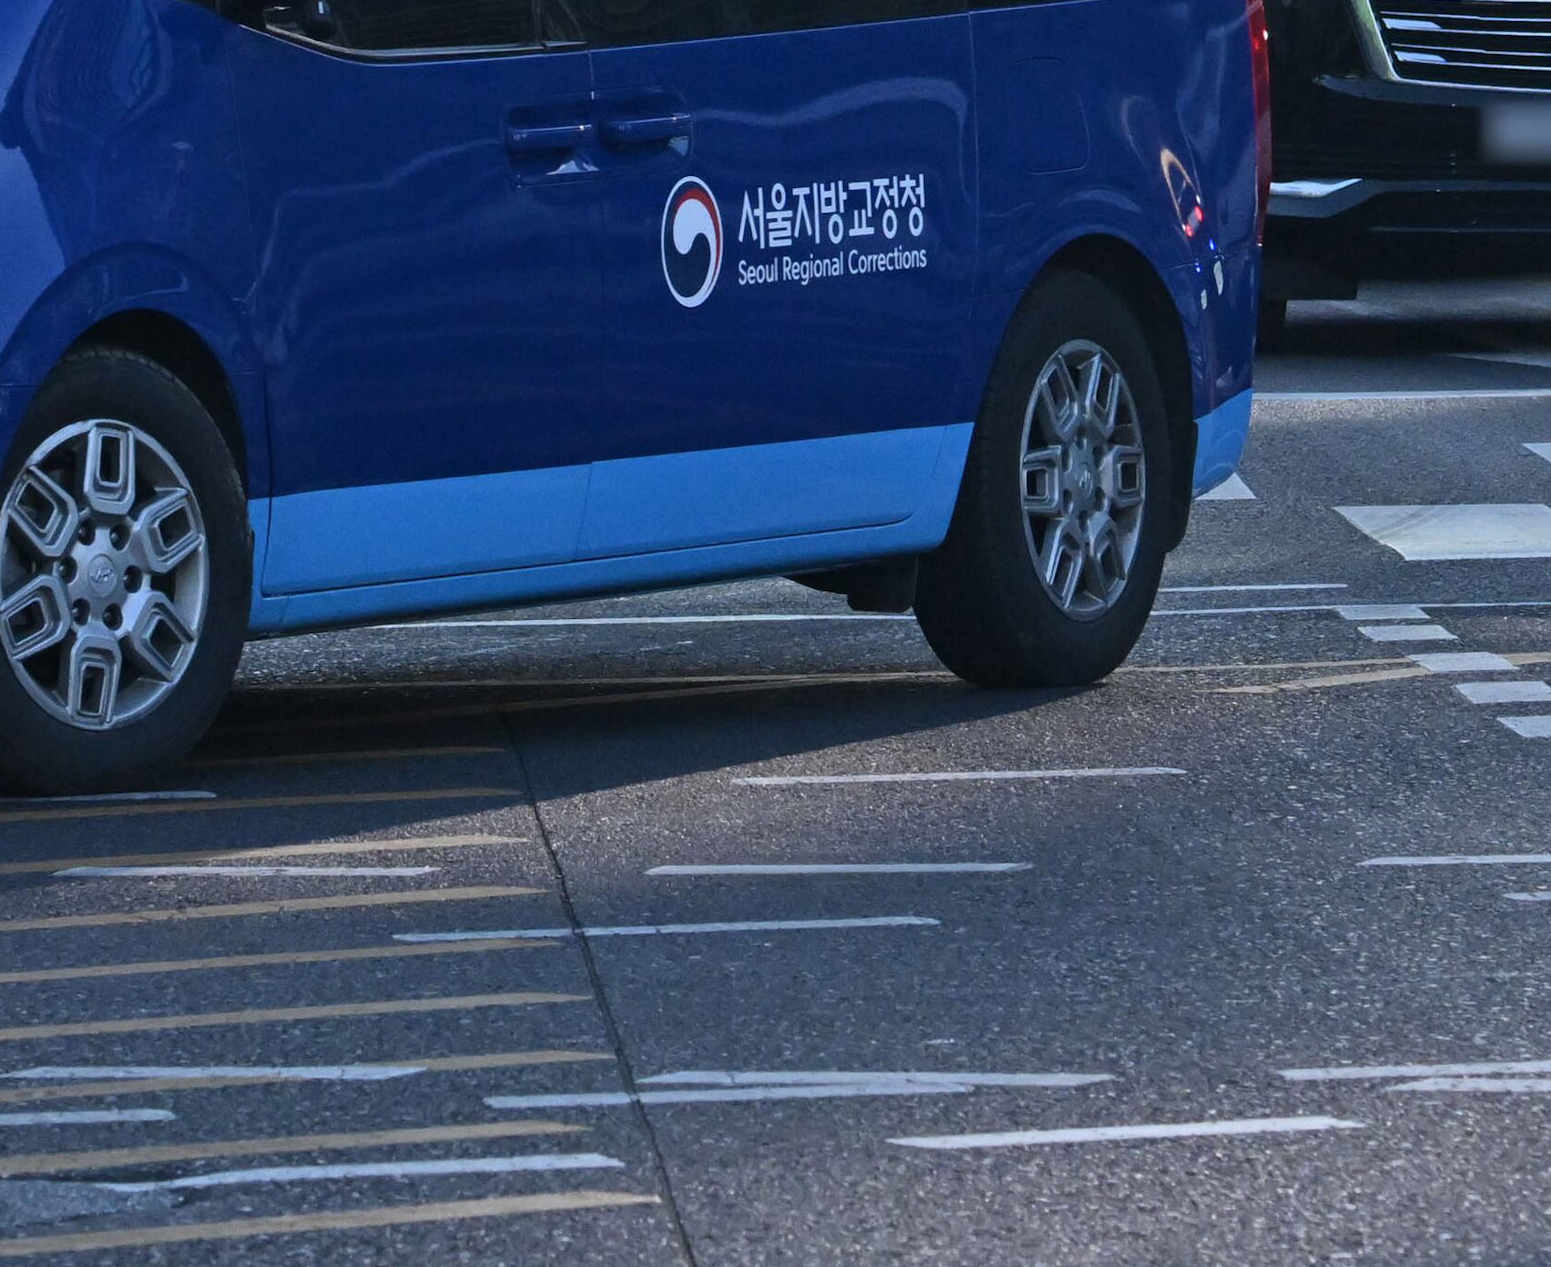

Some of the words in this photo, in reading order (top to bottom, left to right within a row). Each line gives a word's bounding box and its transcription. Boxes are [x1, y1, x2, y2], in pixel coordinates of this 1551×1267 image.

[738, 173, 926, 250] 서울지방교정청
[738, 257, 779, 286] Seoul
[782, 250, 844, 286] Regional
[848, 244, 927, 275] Corrections
